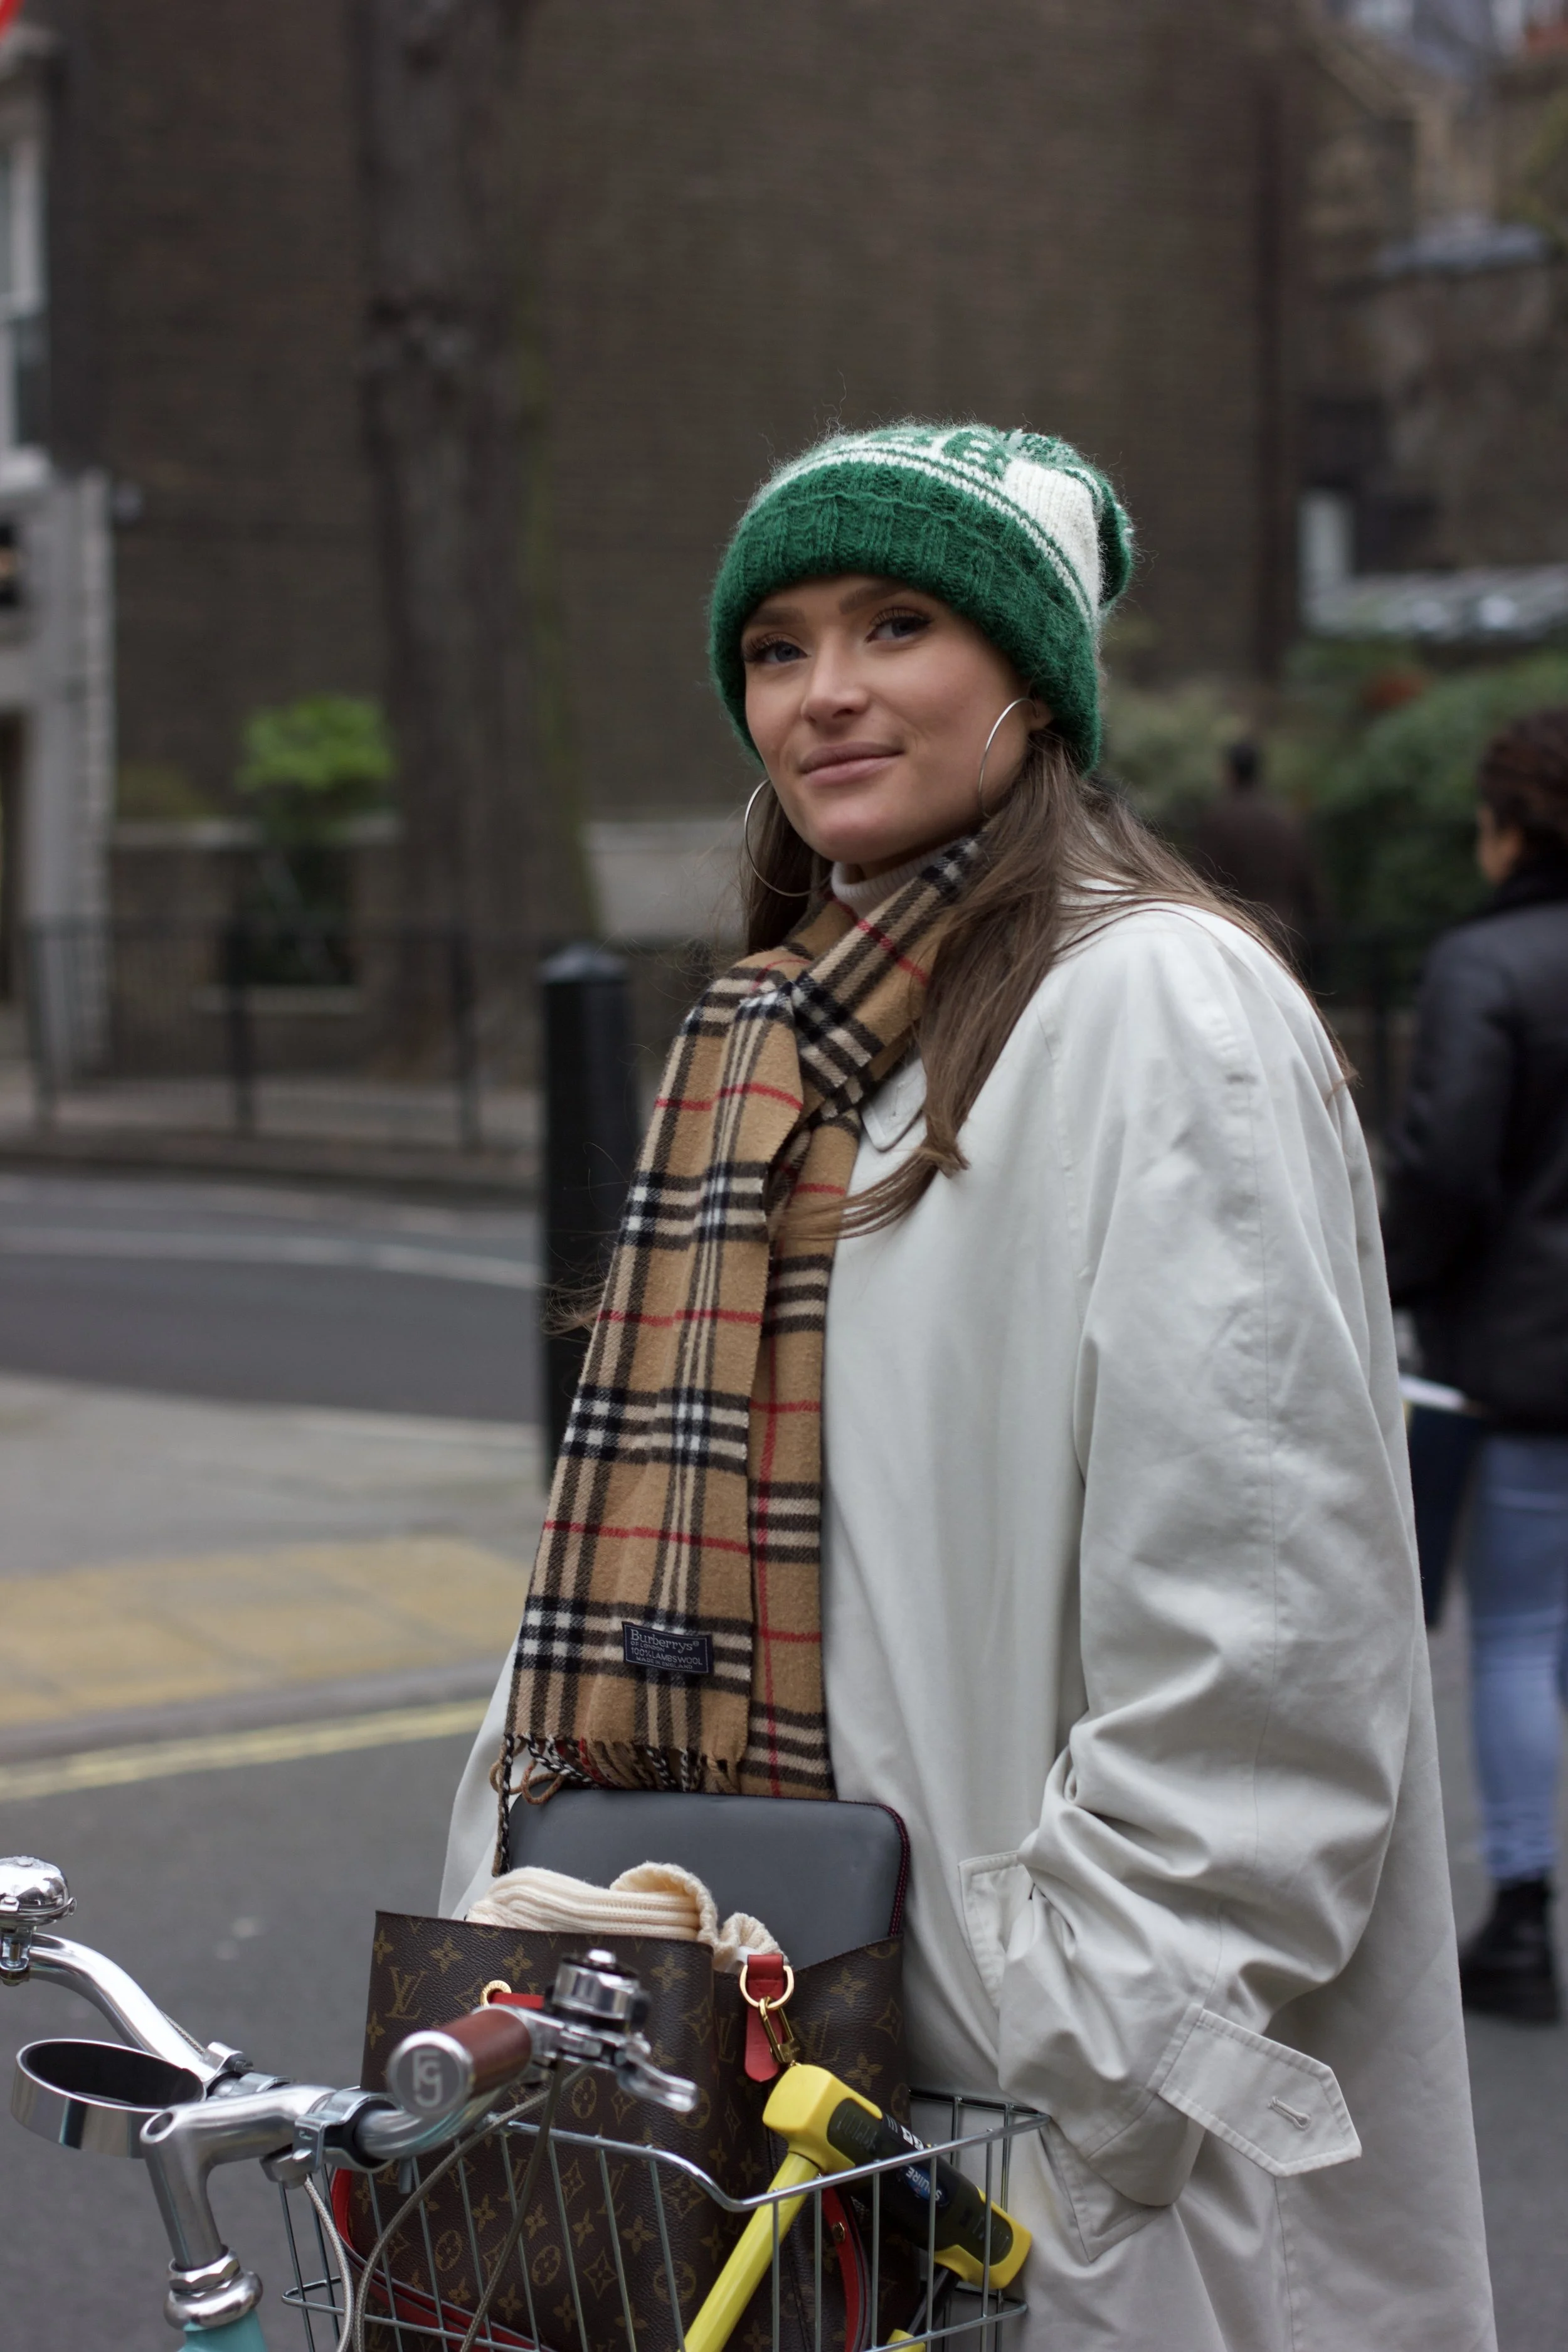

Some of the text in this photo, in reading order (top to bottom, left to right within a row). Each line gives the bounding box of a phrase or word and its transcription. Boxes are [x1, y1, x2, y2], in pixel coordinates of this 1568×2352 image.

[640, 1643, 665, 1652] LONDON
[662, 1660, 693, 1670] ENGLAND
[906, 2166, 943, 2201] SUIRE
